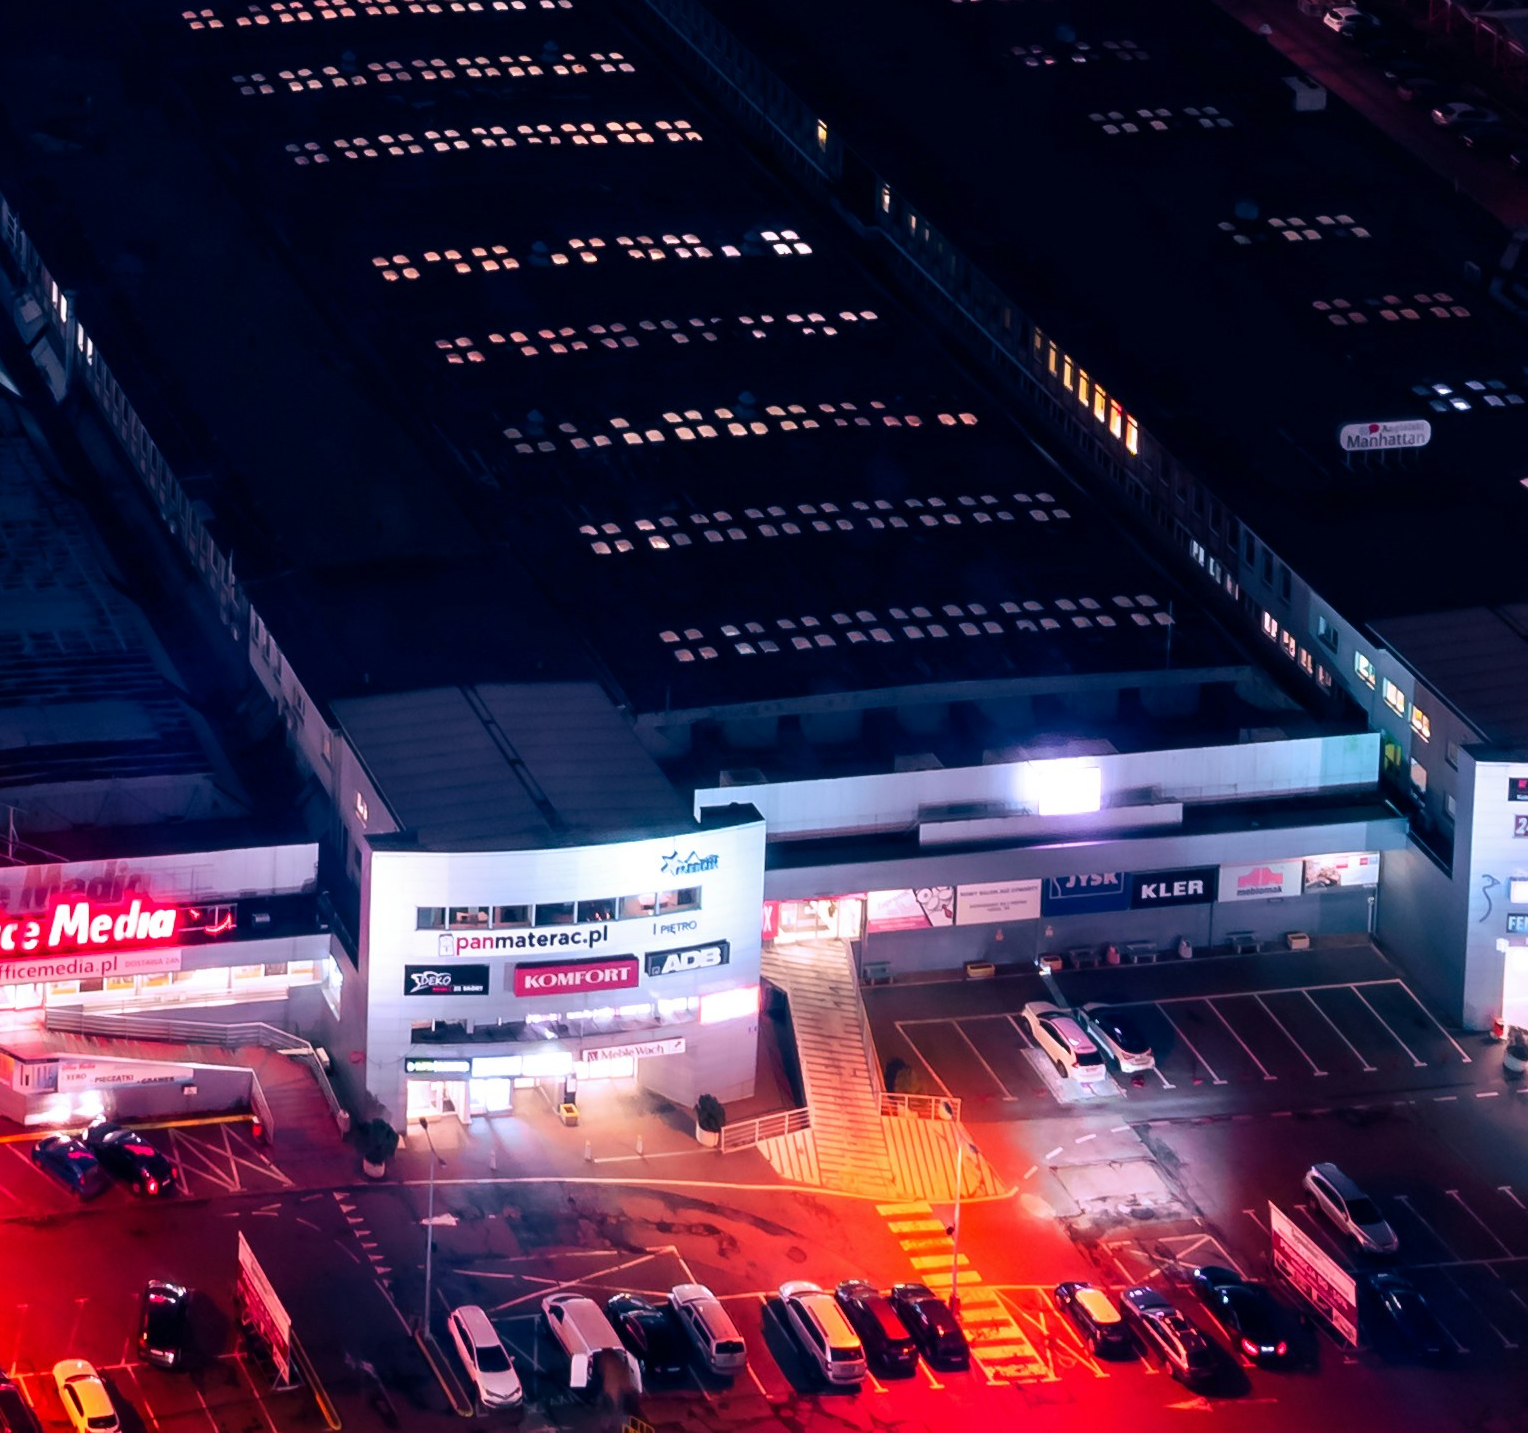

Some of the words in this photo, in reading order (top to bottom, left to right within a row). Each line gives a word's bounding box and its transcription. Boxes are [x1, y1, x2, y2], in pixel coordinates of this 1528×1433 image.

[1347, 432, 1426, 449] Manhattan
[1065, 871, 1119, 888] JYSK
[1141, 879, 1204, 899] KLER
[48, 898, 177, 947] Media
[660, 920, 698, 935] PIĘTRO
[456, 925, 608, 956] panmaterac.pl
[661, 948, 722, 974] ADB
[422, 974, 451, 986] DEKO
[524, 966, 632, 989] KOMFORT
